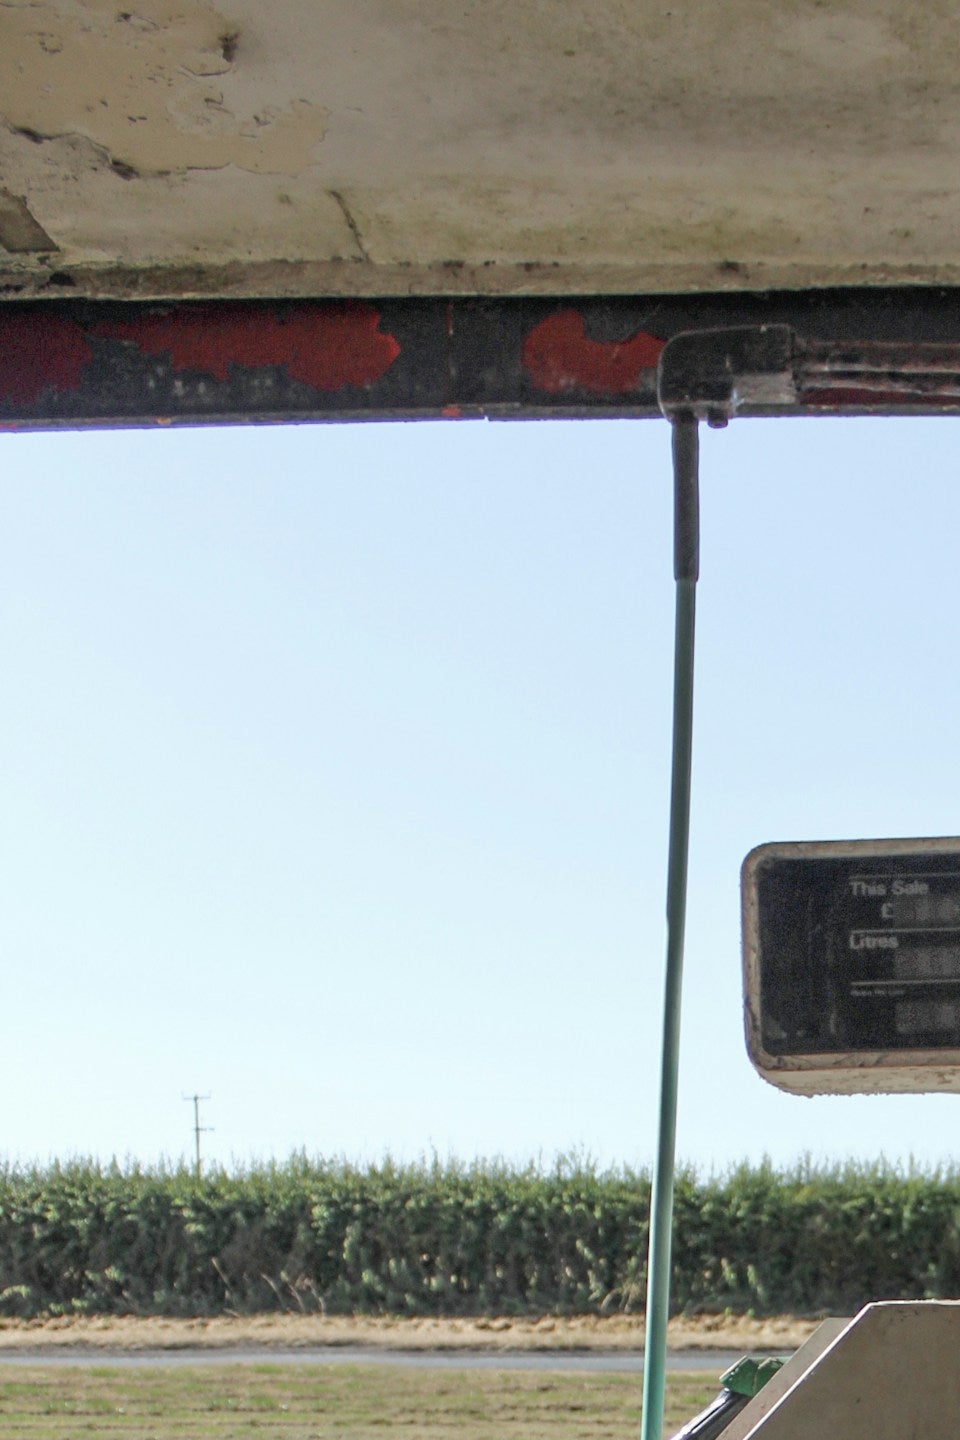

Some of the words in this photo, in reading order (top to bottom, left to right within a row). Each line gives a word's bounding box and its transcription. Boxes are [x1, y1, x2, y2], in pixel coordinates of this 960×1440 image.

[849, 881, 886, 896] This
[891, 879, 929, 896] Sale
[849, 933, 899, 950] Litres
